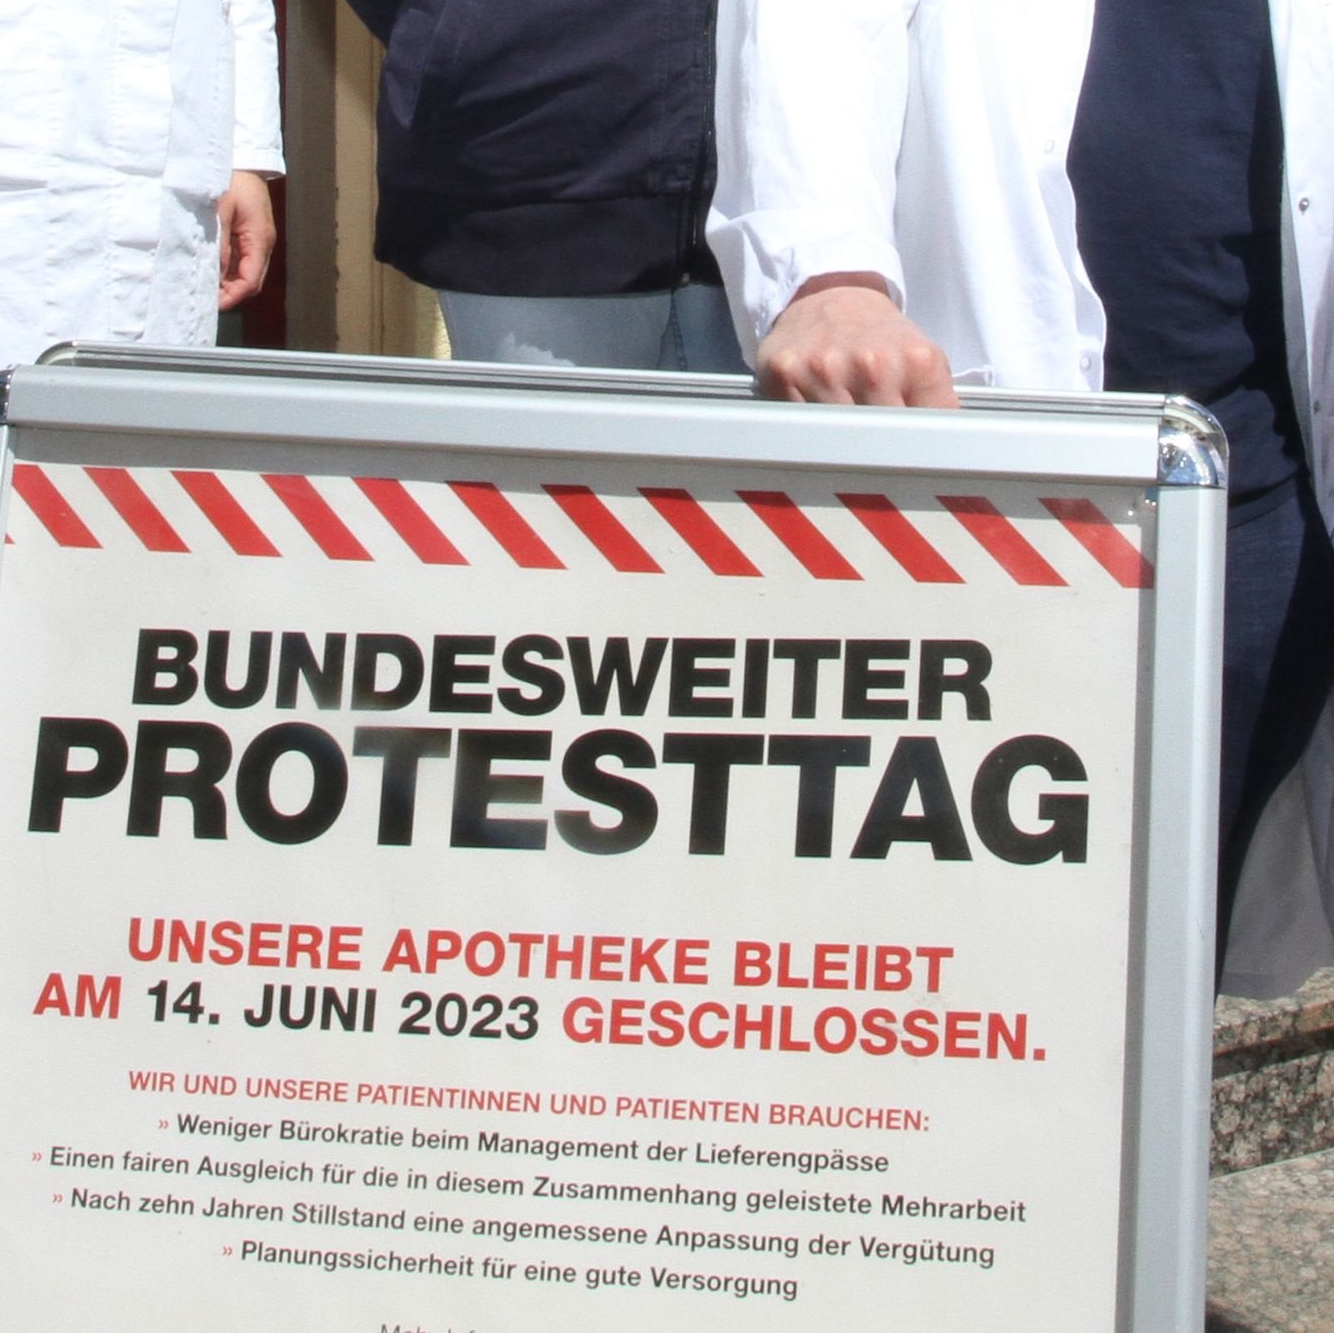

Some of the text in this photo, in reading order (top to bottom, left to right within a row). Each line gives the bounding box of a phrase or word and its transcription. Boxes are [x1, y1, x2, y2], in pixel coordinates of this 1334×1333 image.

[131, 628, 993, 722] BUNDESWEITER
[27, 716, 1091, 866] PROTESTTAG
[128, 917, 954, 993] UNSERE APOTHEKE BLEIBT
[32, 972, 1046, 1061] AM 14. JUNI 2023 GESCHLOSSEN.
[129, 1071, 929, 1131] WIR UND UNSERE PATIENTINNEN UND PATIENTEN BRAUCHEN:
[177, 1113, 889, 1174] Weniger Bürokratie beim Management der Lieferengpässe
[50, 1146, 1026, 1222] Einen fairen Ausgleich für die in diesem Zusammenhang geleistete Mehrarbeit
[71, 1188, 994, 1270] Nach zehn Jahren Stillstand eine angemessene Anpassung der Vergütung
[241, 1240, 798, 1302] Planungssicherheit für eine gute Versorgung
